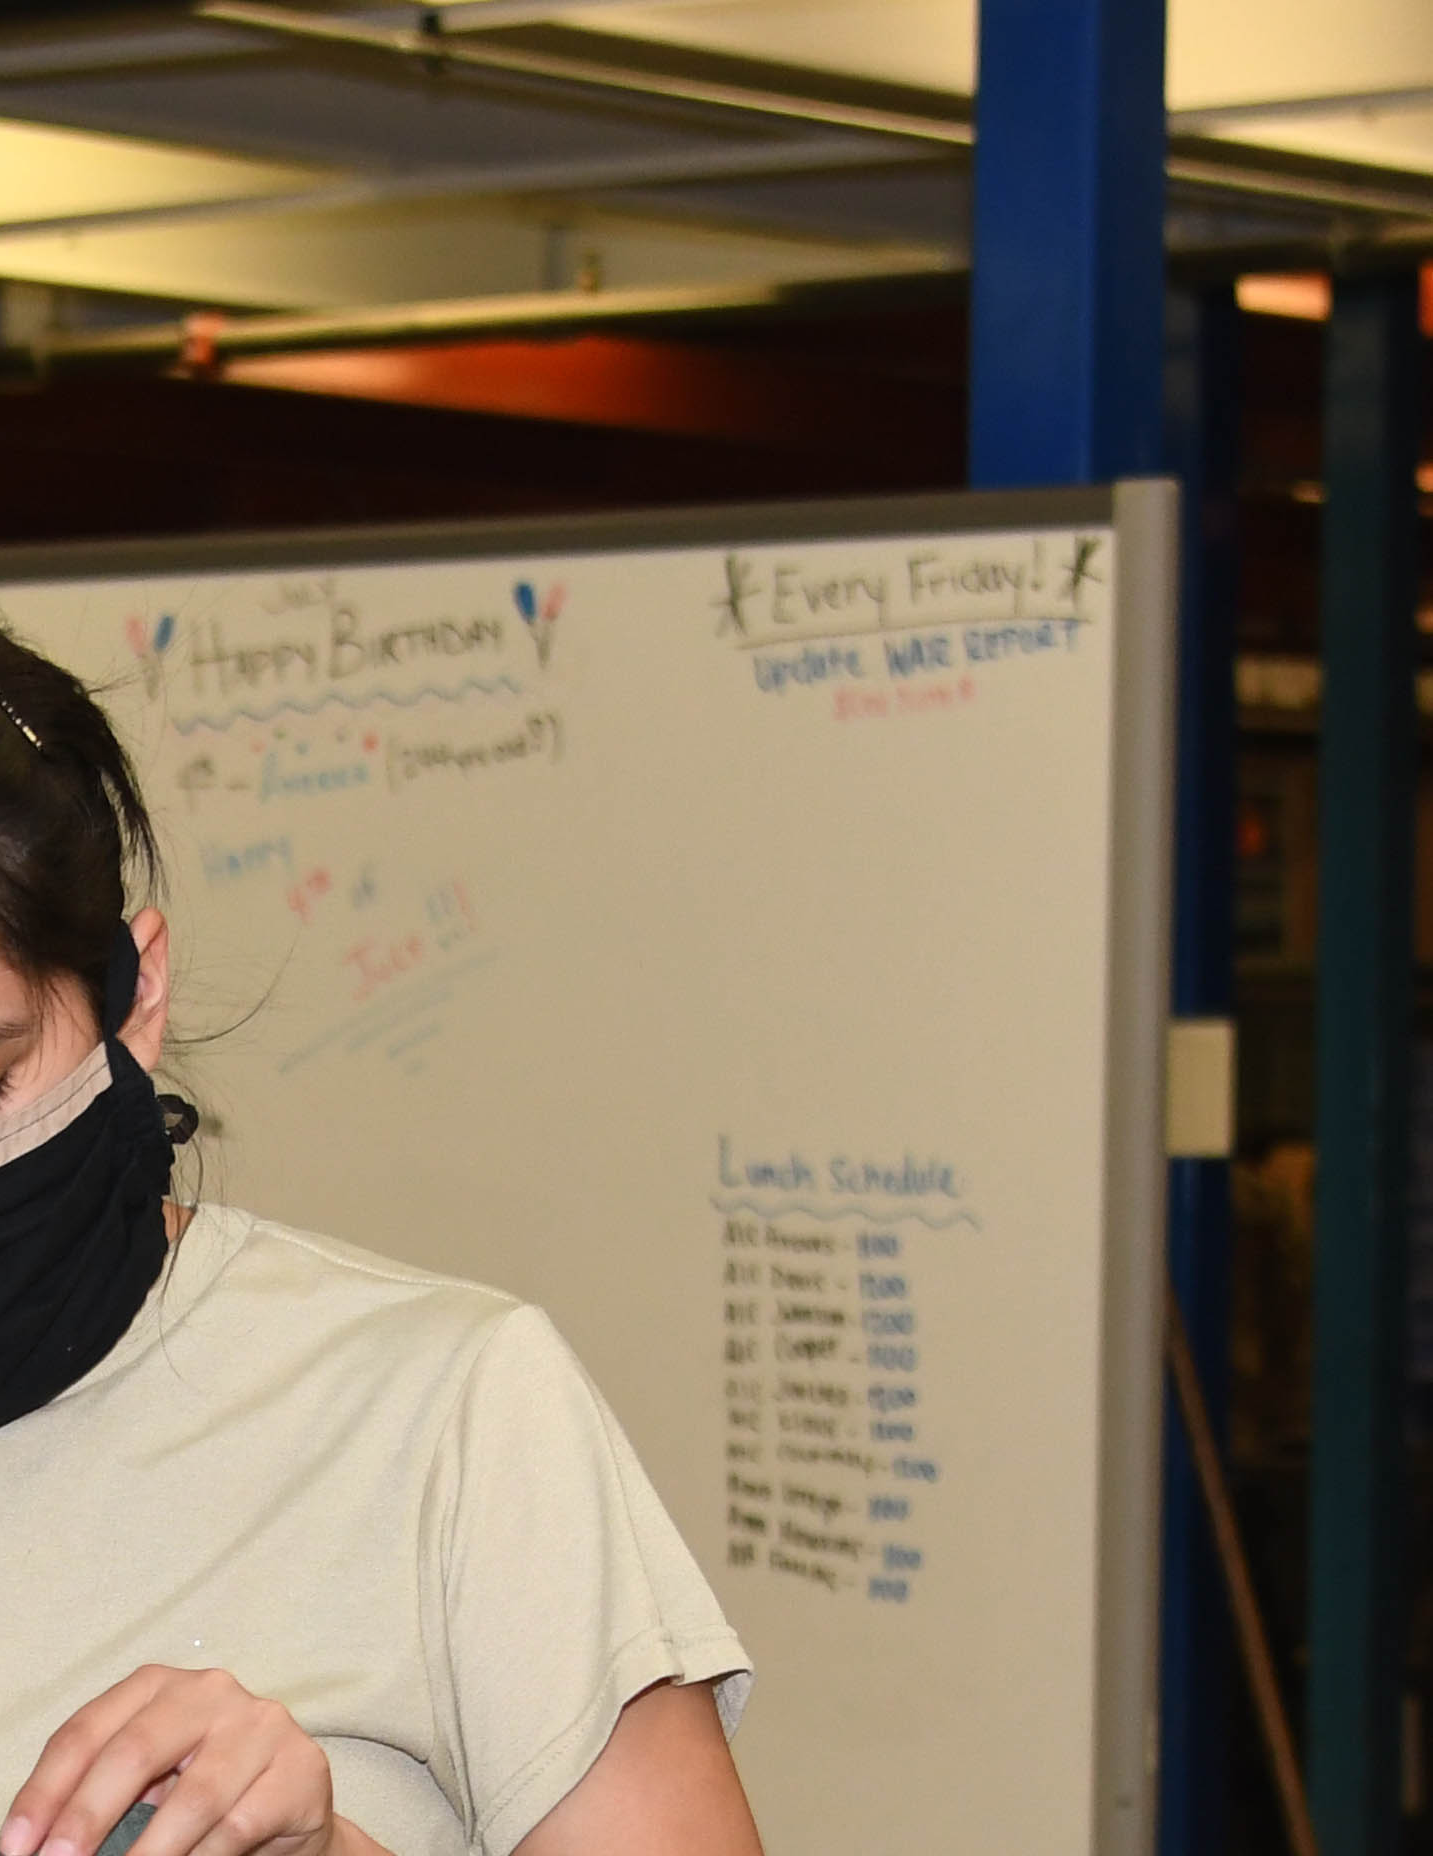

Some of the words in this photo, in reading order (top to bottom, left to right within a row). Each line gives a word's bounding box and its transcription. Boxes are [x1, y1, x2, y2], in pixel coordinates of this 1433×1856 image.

[772, 565, 886, 626] Every
[907, 540, 1043, 616] Friday!
[718, 1132, 816, 1190] Lunch
[829, 1154, 962, 1199] Schedule
